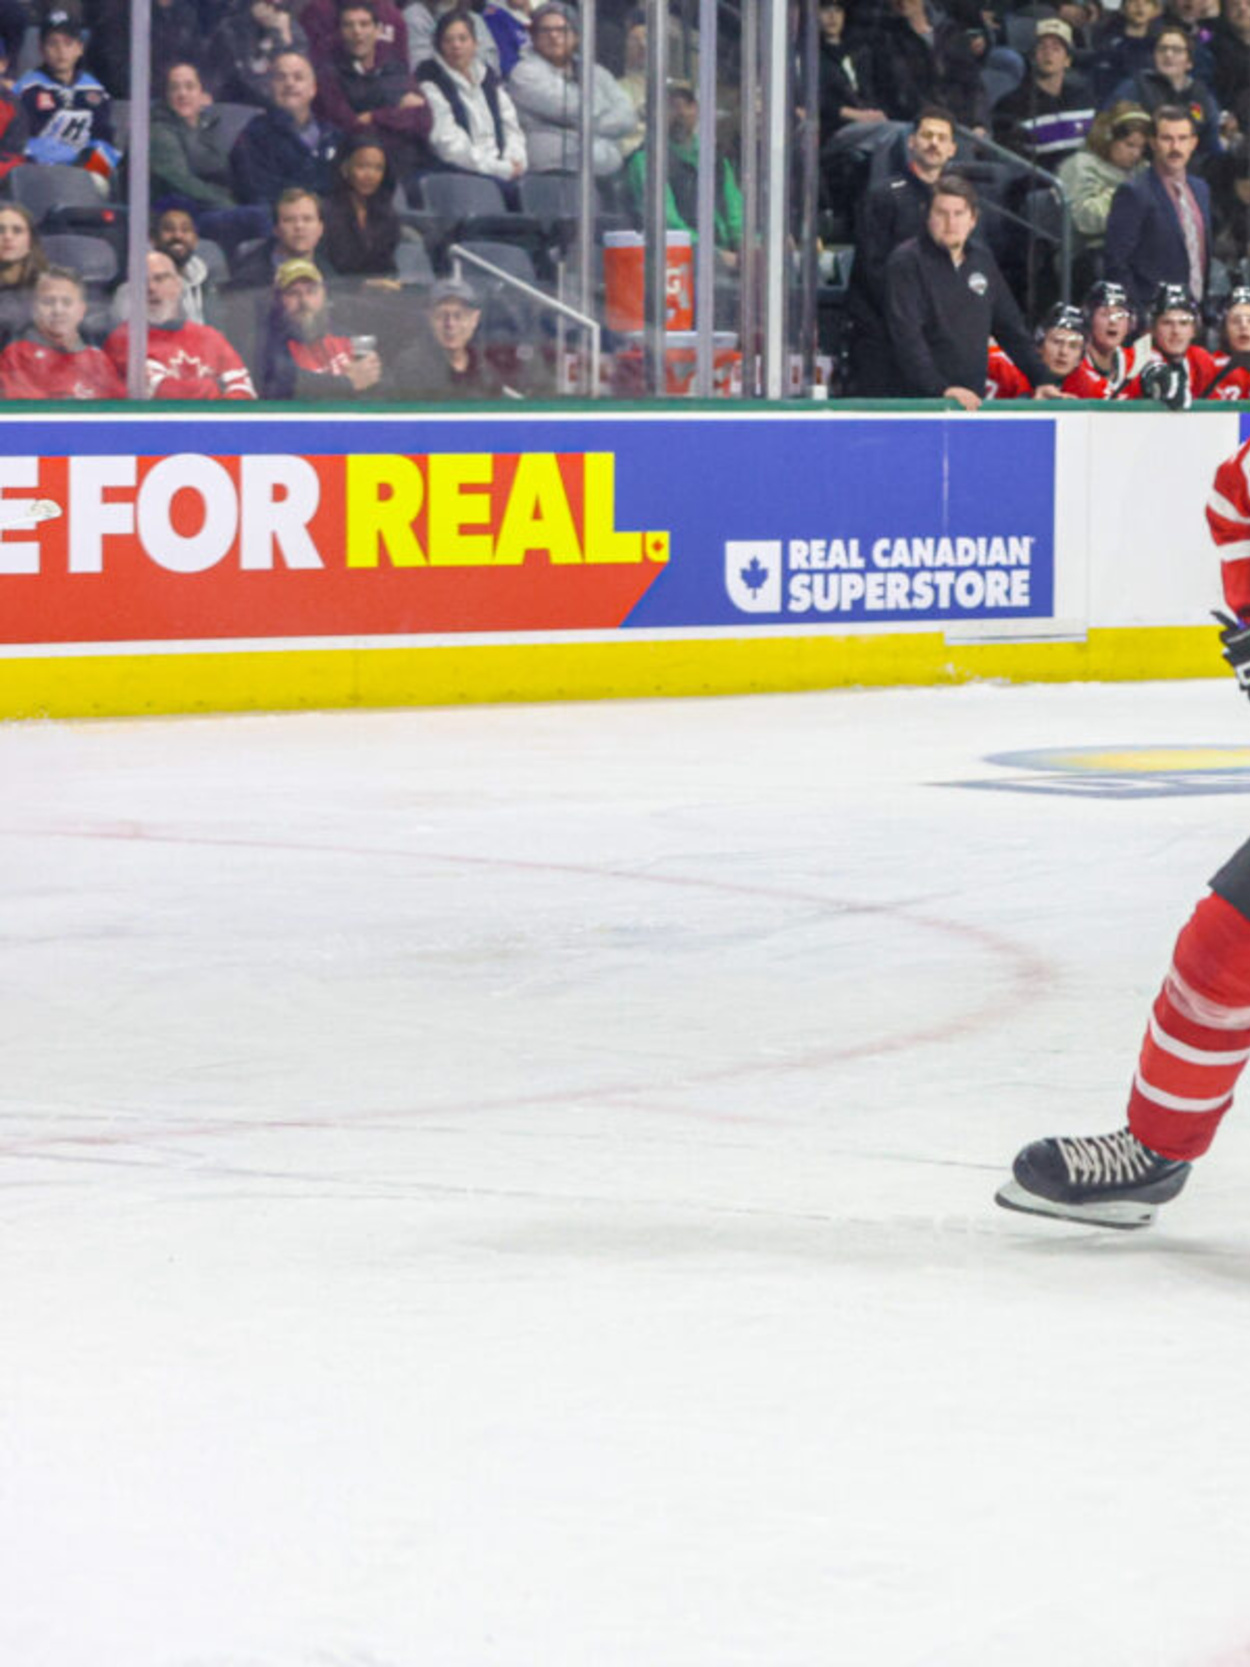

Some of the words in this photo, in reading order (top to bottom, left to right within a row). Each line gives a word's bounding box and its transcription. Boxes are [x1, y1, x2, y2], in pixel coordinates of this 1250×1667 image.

[68, 453, 325, 573] FOR
[788, 539, 866, 570] REAL
[871, 537, 1031, 568] CANADIAN
[787, 569, 1031, 613] SUPERSTORE
